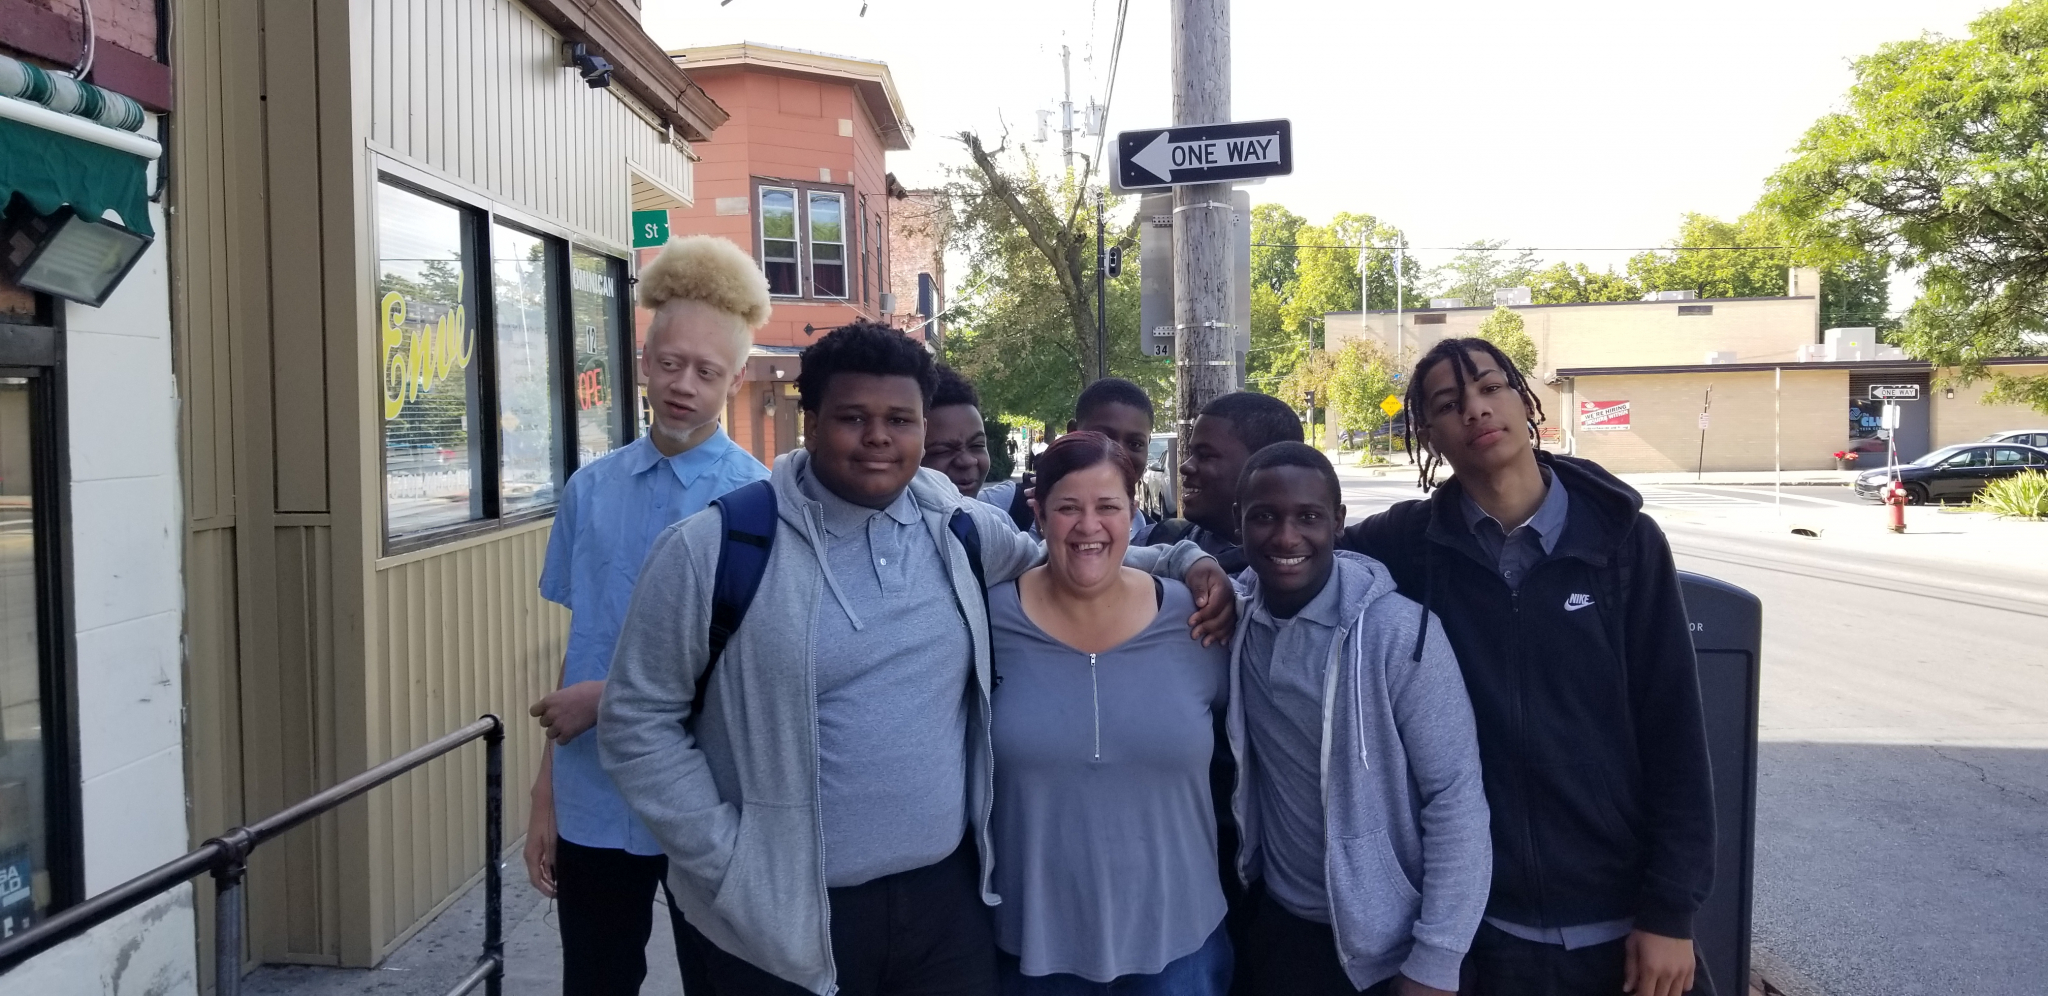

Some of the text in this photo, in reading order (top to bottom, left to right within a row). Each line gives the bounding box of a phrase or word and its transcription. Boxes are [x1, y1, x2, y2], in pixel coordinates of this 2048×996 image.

[1171, 138, 1273, 167] ONE WAY
[645, 223, 658, 239] St
[1155, 345, 1168, 356] 34
[1605, 405, 1627, 414] HIRING
[1569, 593, 1590, 605] NIKE
